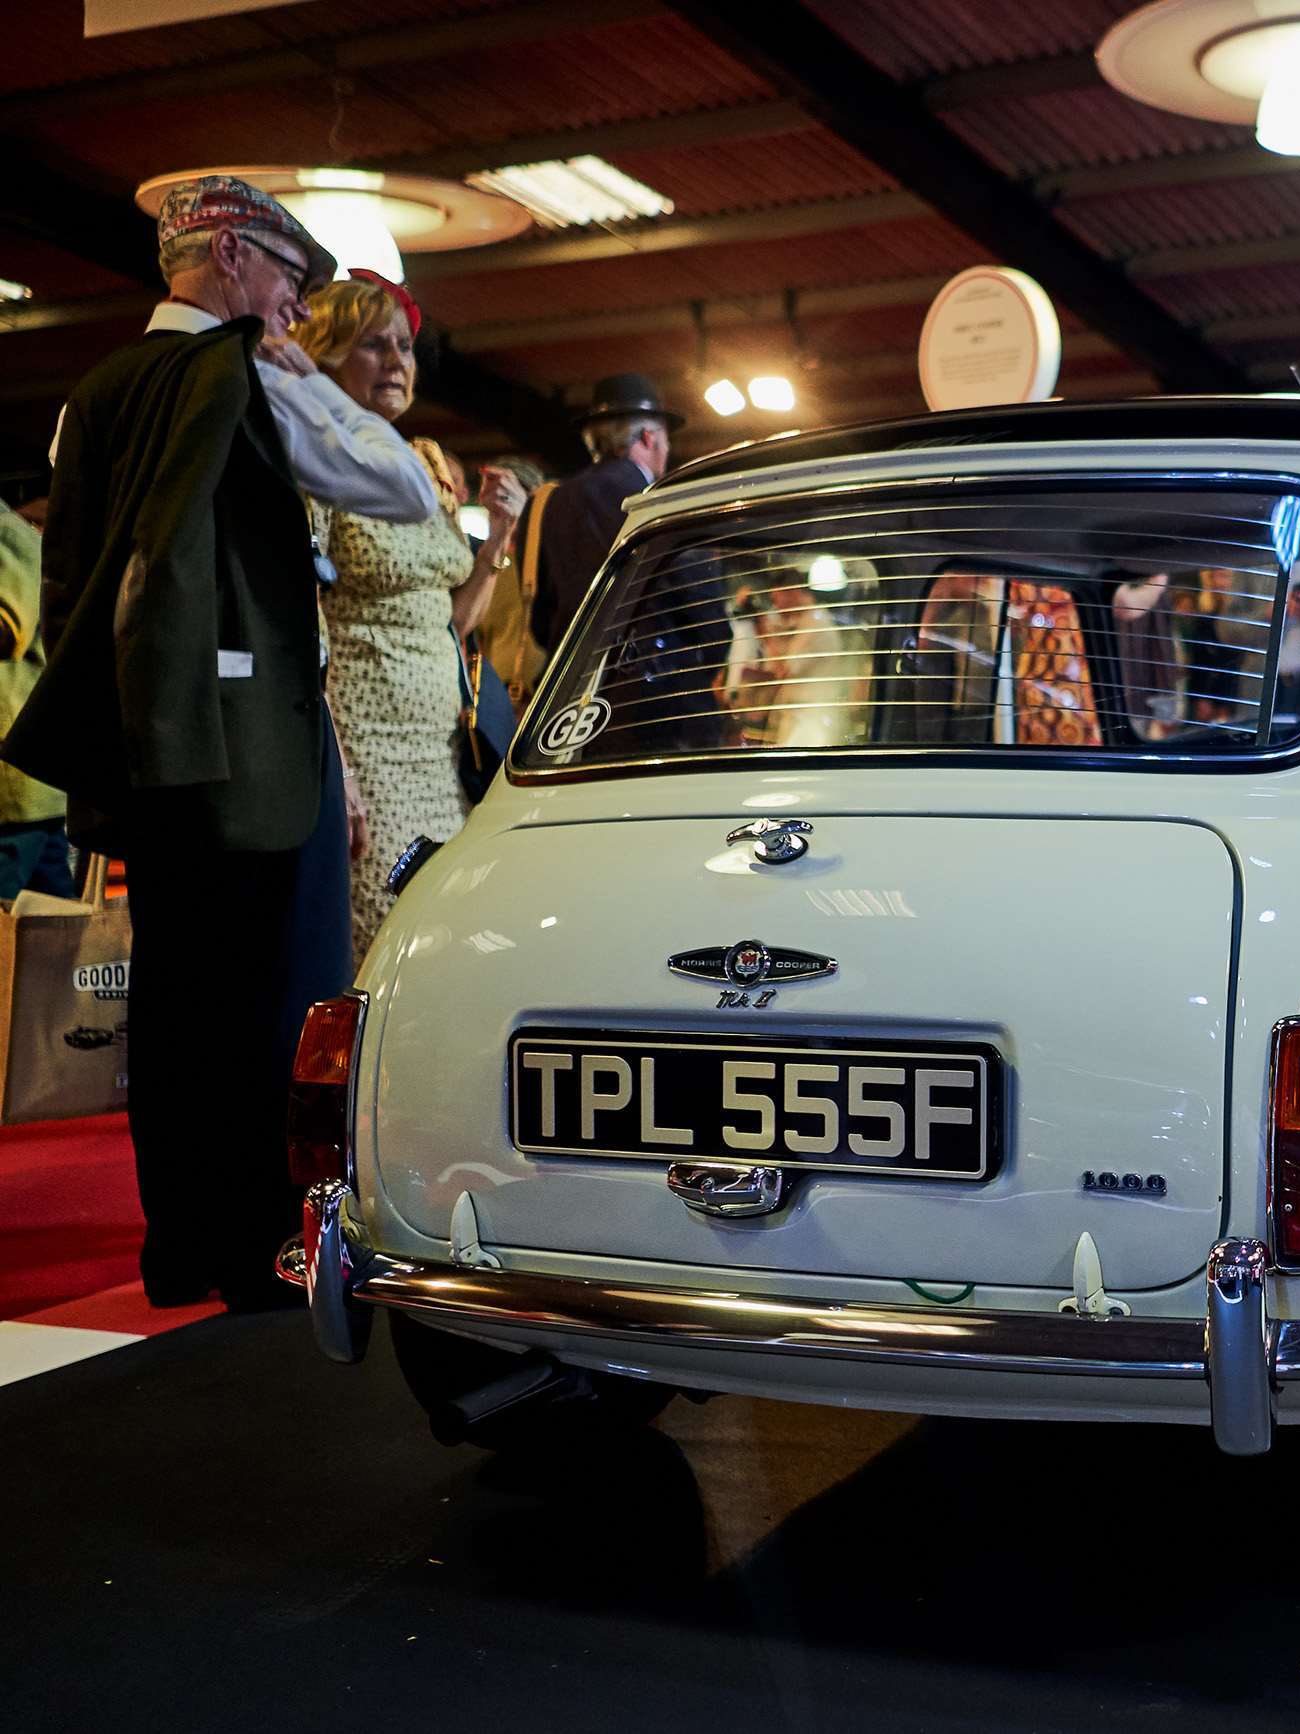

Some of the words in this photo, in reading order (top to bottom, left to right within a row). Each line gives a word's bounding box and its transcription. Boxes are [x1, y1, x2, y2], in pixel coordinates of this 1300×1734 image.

[547, 705, 601, 748] GB
[680, 959, 722, 968] MORRIS
[775, 960, 820, 970] COOPER
[523, 1052, 693, 1145] TPL
[722, 1060, 975, 1160] 555F
[1082, 1170, 1167, 1193] 1000
